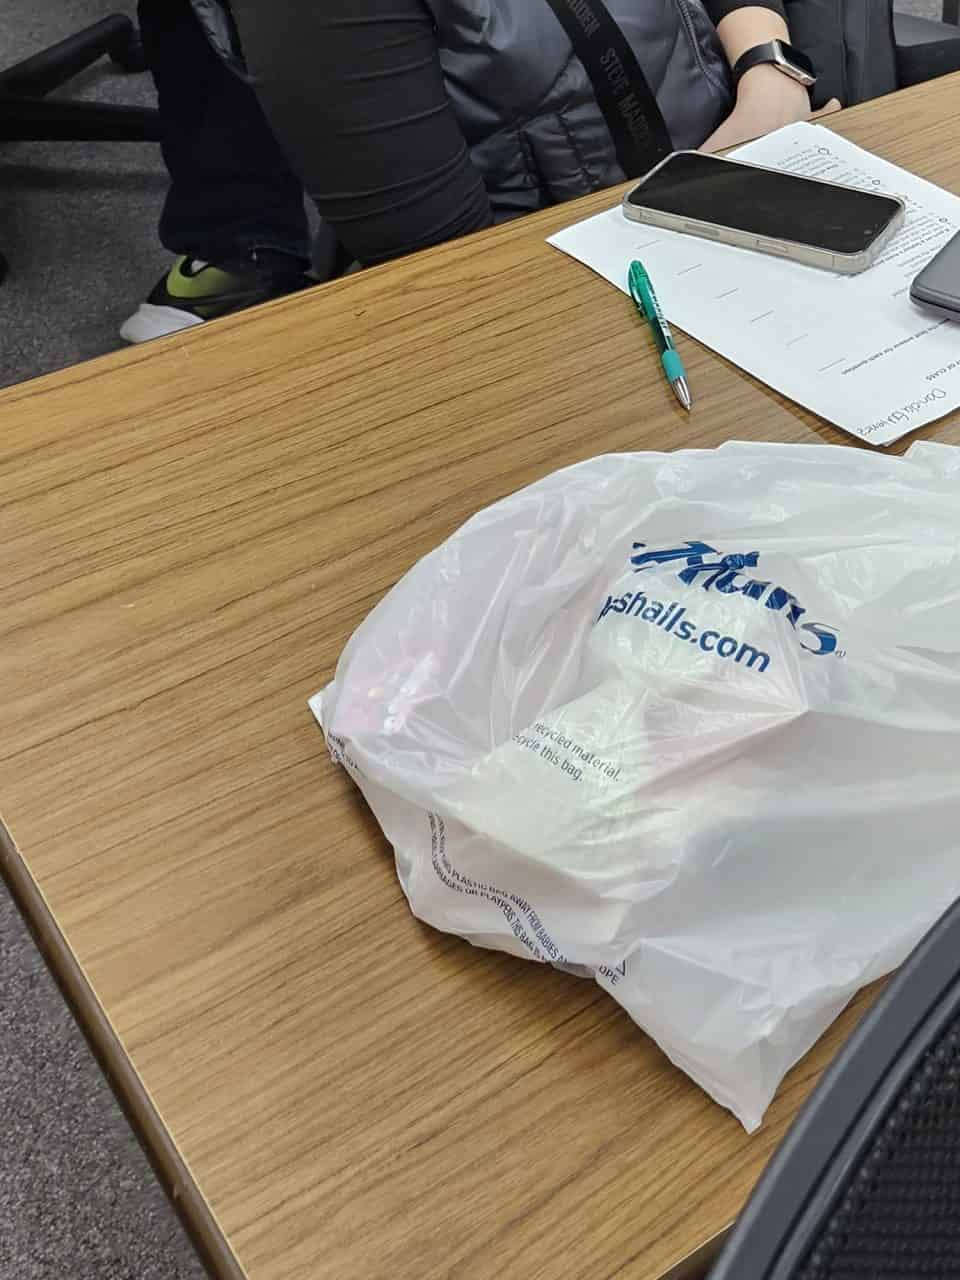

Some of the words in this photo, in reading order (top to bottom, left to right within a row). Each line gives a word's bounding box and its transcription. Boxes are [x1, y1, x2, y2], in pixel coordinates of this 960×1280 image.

[600, 47, 631, 97] STEVE
[540, 744, 560, 766] this
[560, 759, 583, 782] bag.
[571, 743, 620, 781] material.
[510, 894, 531, 914] AWAY
[527, 910, 543, 932] FROM
[535, 927, 559, 959] BABIES
[511, 918, 524, 937] THIS
[520, 931, 534, 951] BAG
